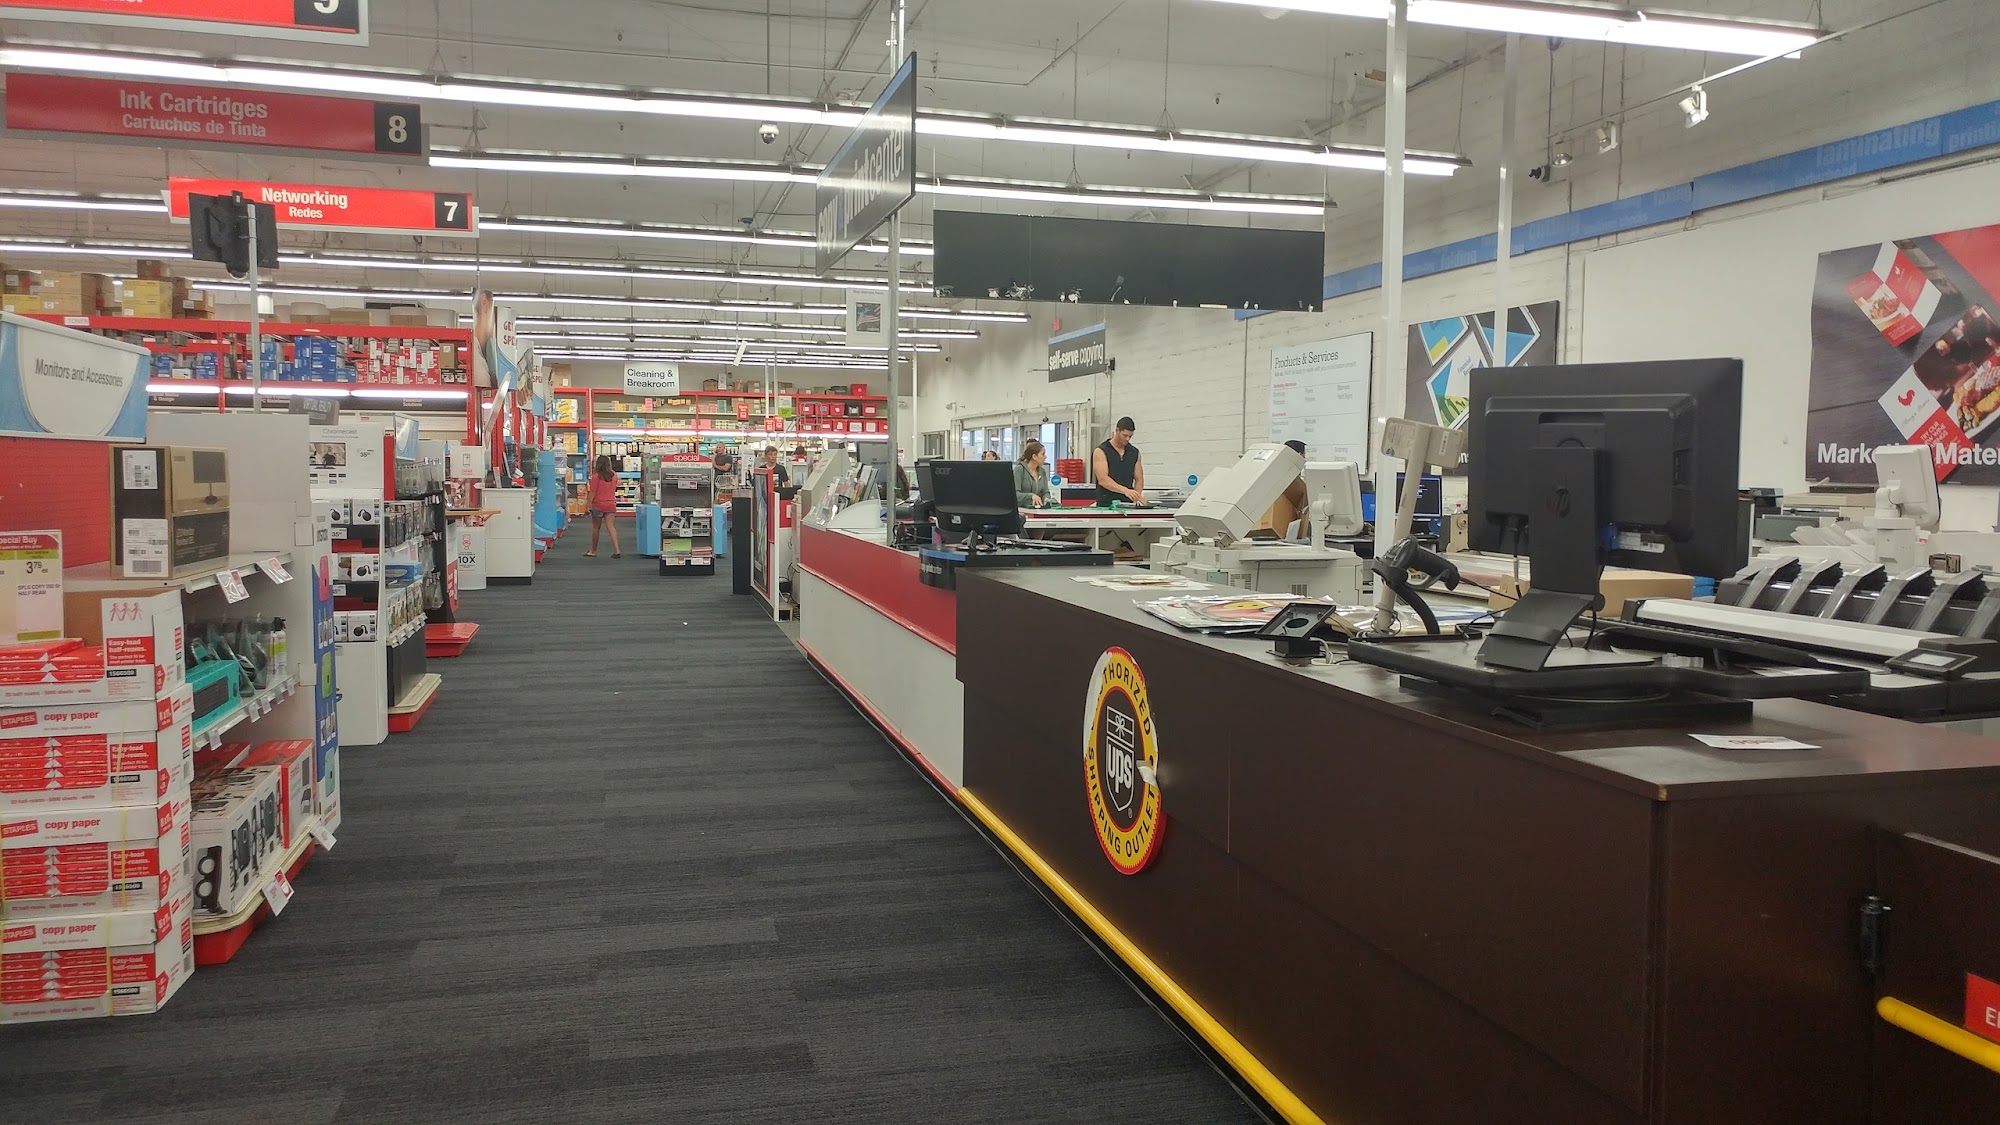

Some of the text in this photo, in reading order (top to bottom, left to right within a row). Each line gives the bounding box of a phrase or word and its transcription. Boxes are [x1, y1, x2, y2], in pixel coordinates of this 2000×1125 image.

[120, 90, 268, 121] Ink Cartridges
[122, 114, 267, 137] Cartuchos de Tinta
[388, 115, 408, 143] 8
[1817, 119, 1941, 166] laminating
[261, 187, 348, 209] Networking
[289, 206, 324, 219] Redes
[443, 202, 459, 221] 7
[1049, 341, 1104, 371] self-serve copying
[1274, 350, 1340, 369] Products & Services
[35, 358, 123, 387] Monitors and Accessories
[627, 368, 674, 379] Cleaning &
[627, 378, 675, 388] Breakroom
[673, 454, 700, 462] special
[22, 535, 38, 545] Buy
[458, 556, 476, 564] 10X
[109, 639, 141, 647] Easy-load
[1100, 661, 1151, 736] THORIZED
[2, 711, 100, 726] STAPLES copy paper
[1107, 744, 1133, 793] ups
[1088, 746, 1156, 859] SHIPPING OUTLET
[3, 819, 101, 835] STAPLES copy paper
[2, 924, 97, 940] STAPLES copy paper
